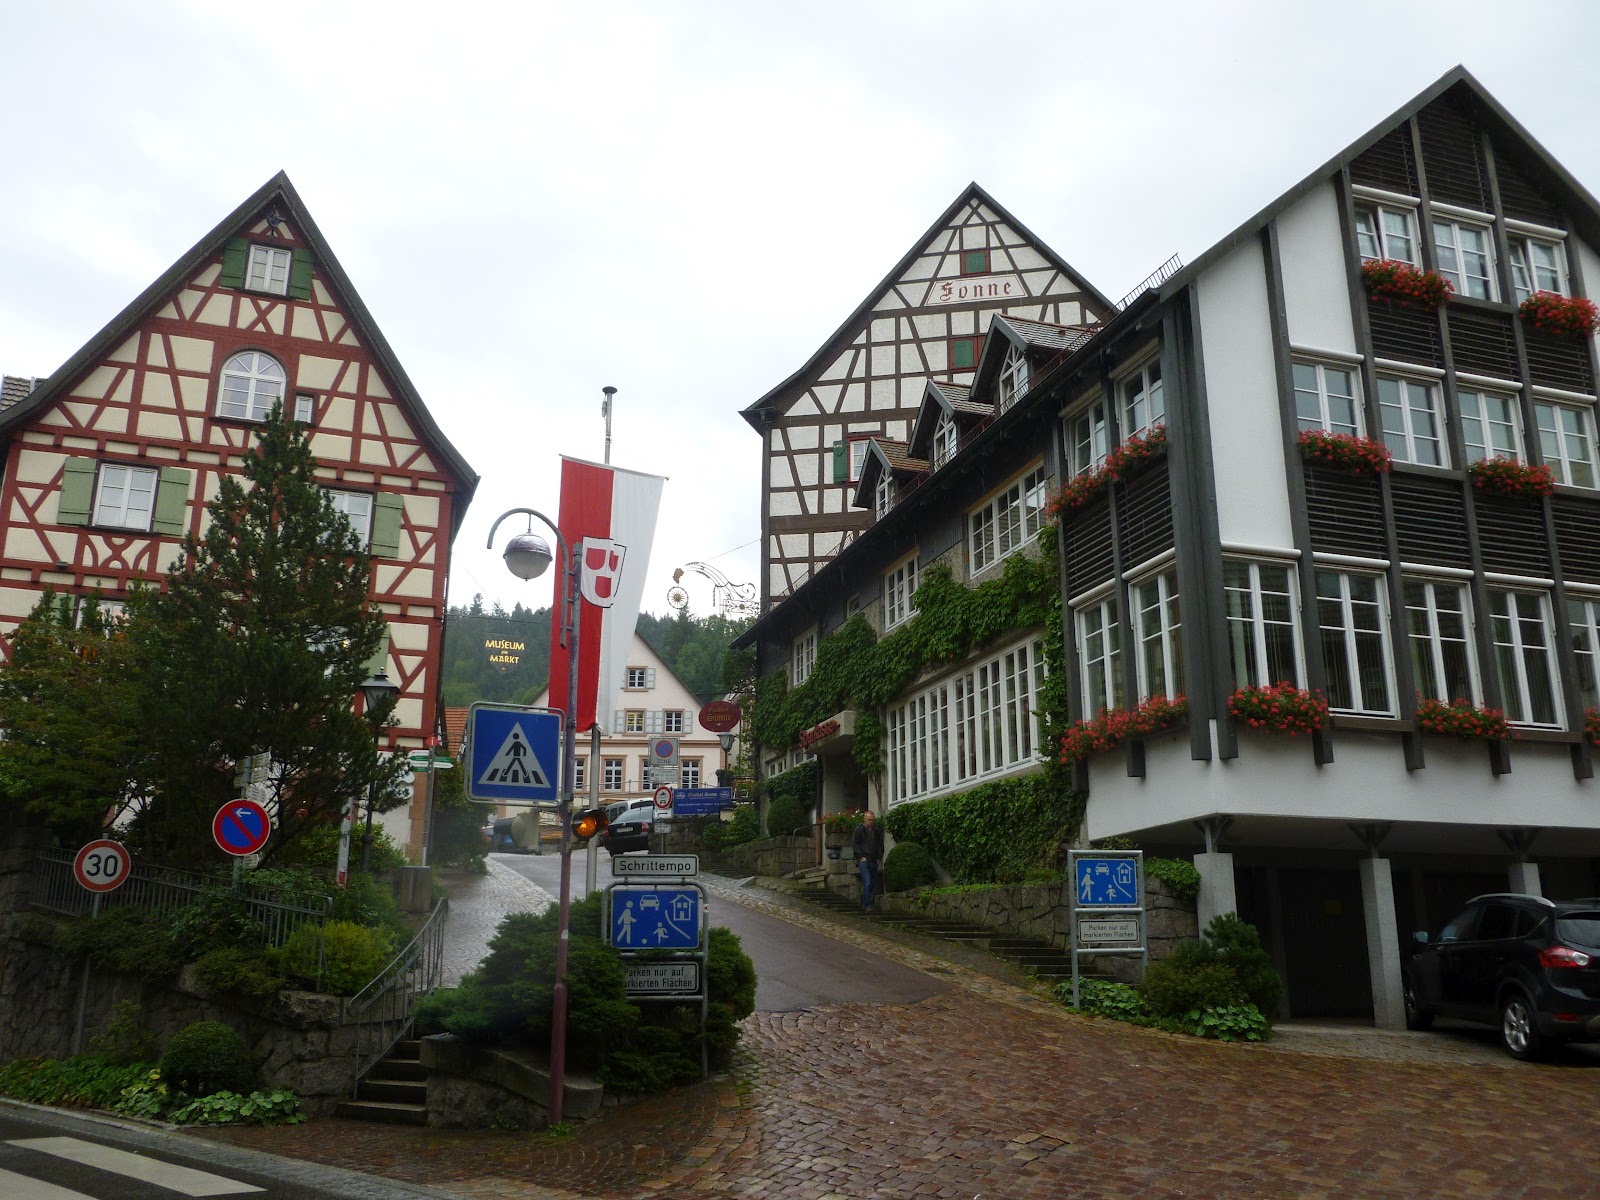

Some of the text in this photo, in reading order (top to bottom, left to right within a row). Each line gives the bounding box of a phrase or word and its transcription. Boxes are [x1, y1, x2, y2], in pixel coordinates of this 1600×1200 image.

[940, 281, 1011, 301] Sonne
[485, 640, 525, 650] MUSEUM
[490, 655, 519, 663] MARKT
[705, 713, 732, 722] Sonne
[86, 854, 119, 877] 30
[619, 860, 691, 873] Schrittempo
[624, 967, 651, 976] Parken
[671, 967, 684, 976] auf
[662, 977, 692, 987] Flächen
